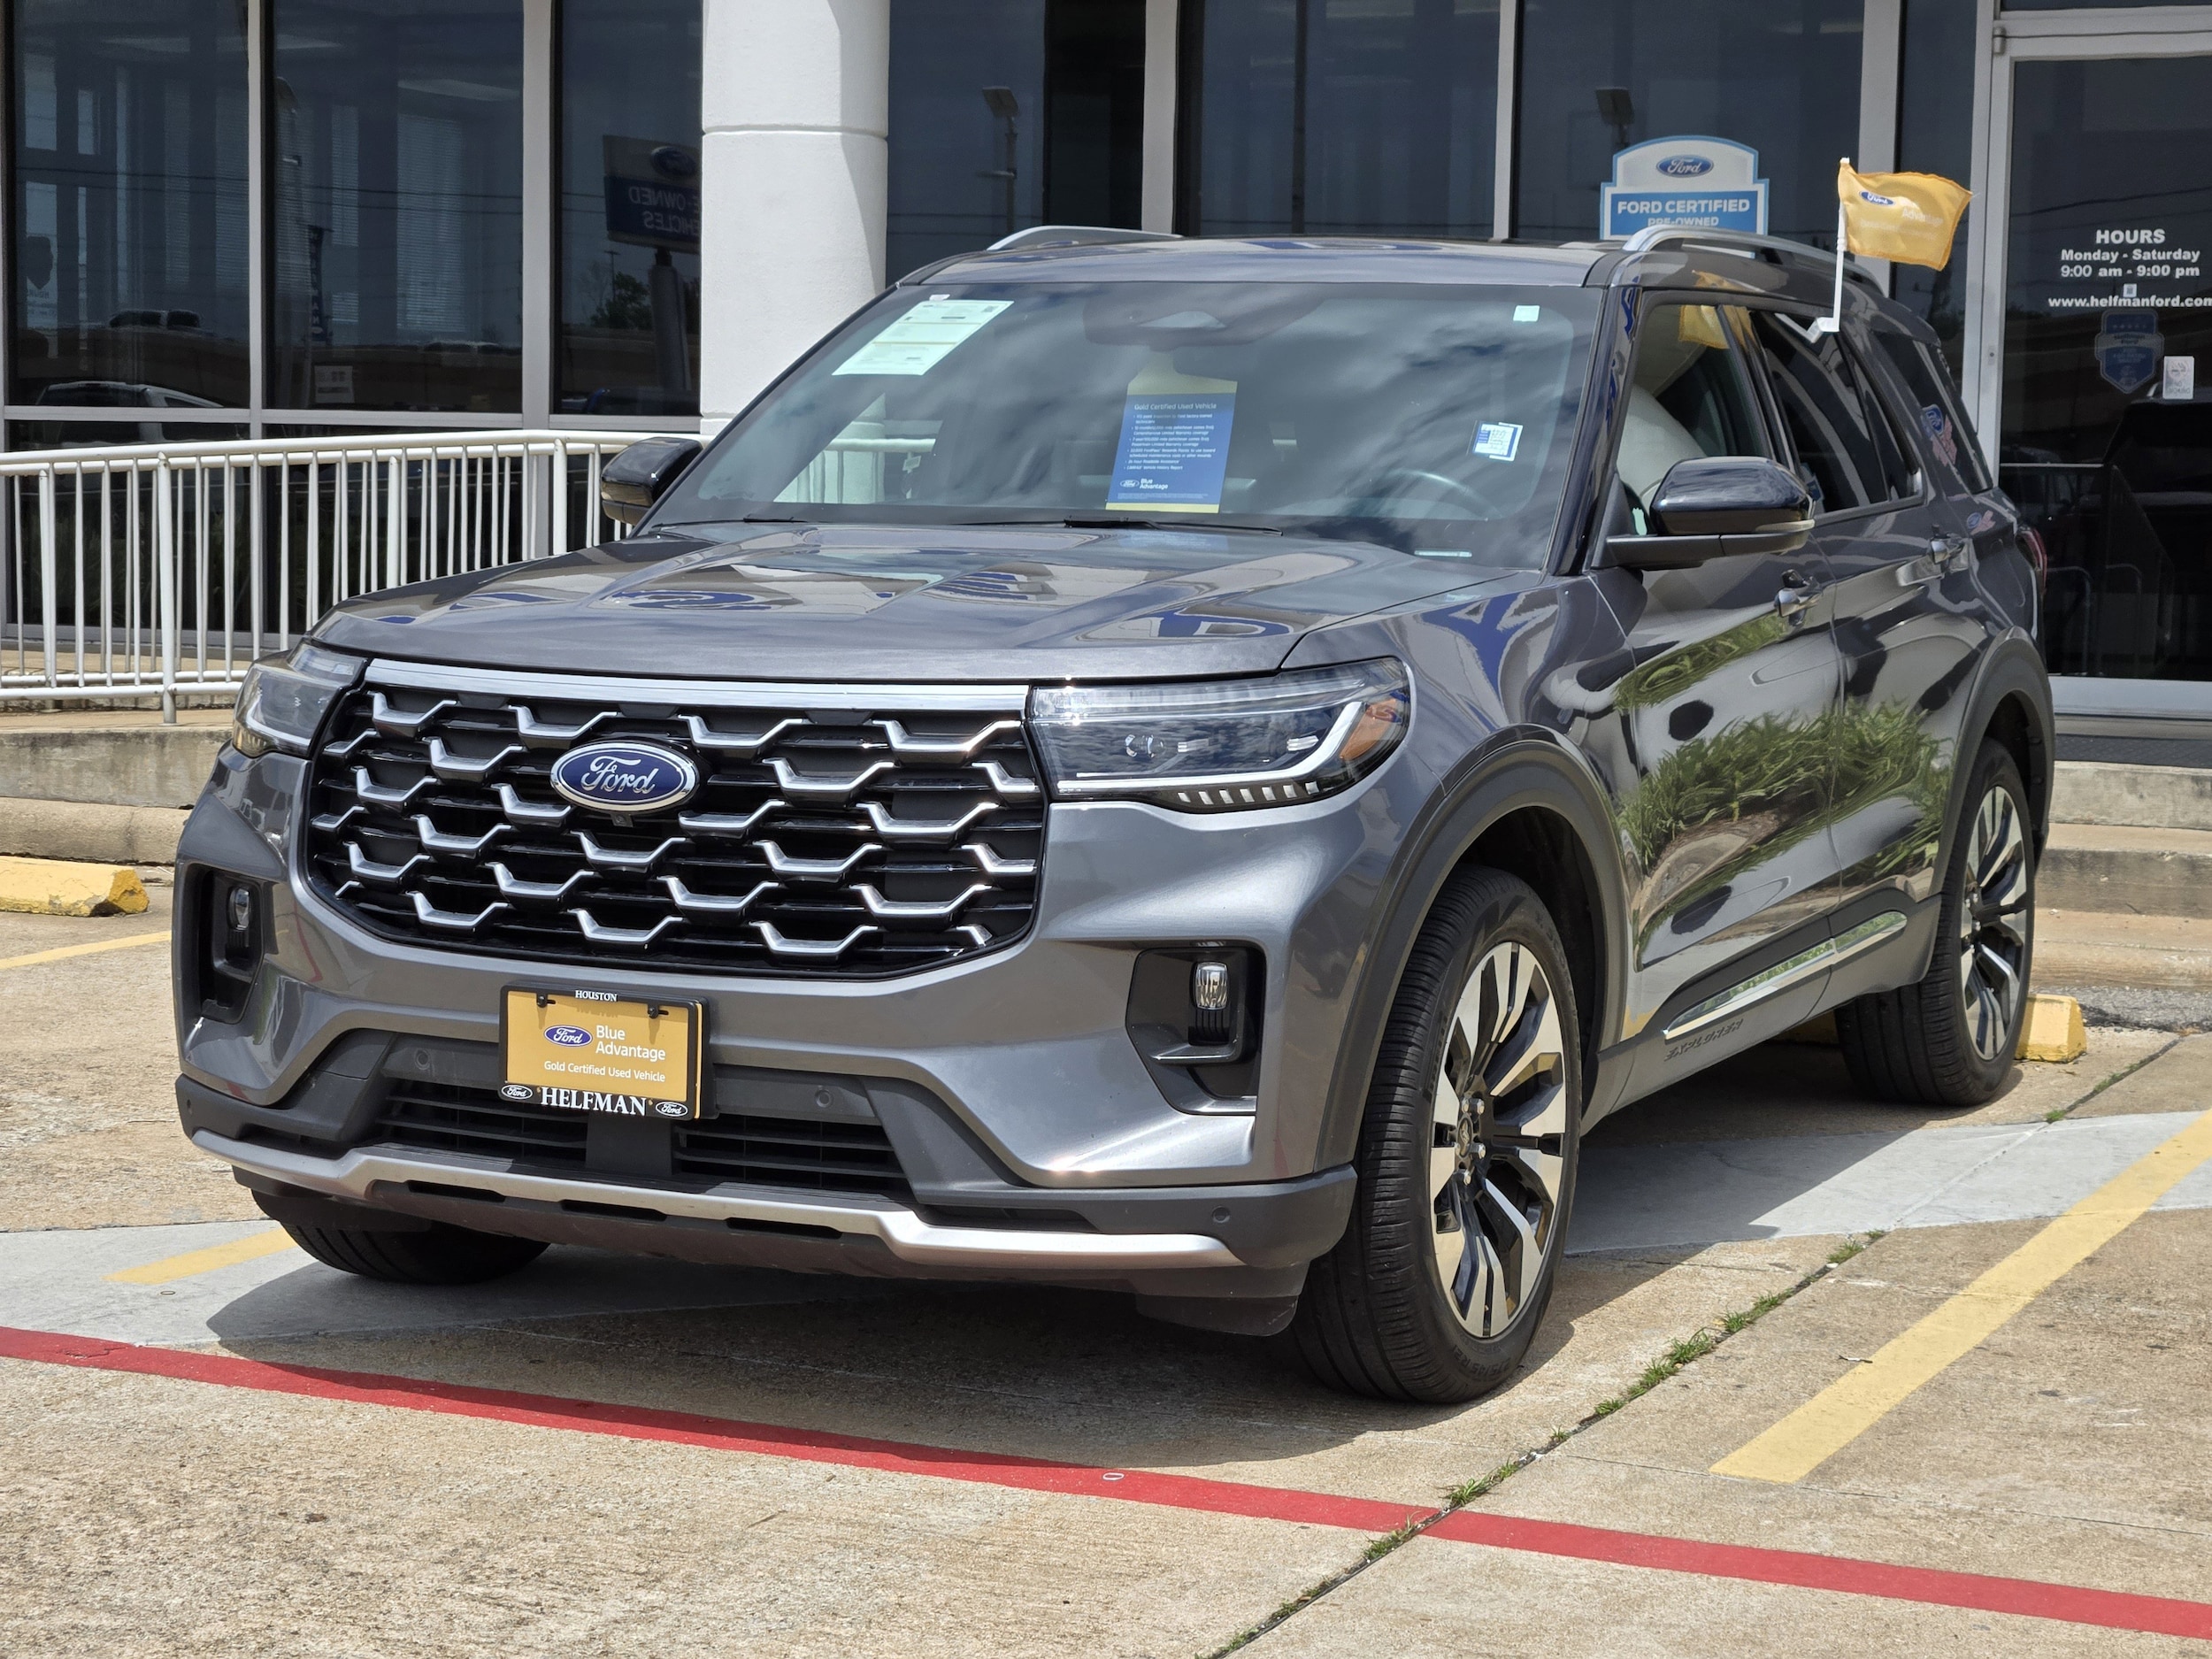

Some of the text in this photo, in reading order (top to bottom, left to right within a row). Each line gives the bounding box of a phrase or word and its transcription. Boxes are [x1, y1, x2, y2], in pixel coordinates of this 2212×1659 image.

[1667, 157, 1702, 174] Ford
[1617, 198, 1750, 215] FORD CERTIFIED
[1647, 217, 1719, 227] PRE-OWNED
[2095, 229, 2166, 244] HOURS
[2061, 249, 2119, 263] Monday
[2131, 249, 2200, 263] Saturday
[2061, 265, 2093, 277] 9:00
[2098, 266, 2123, 277] am
[2136, 265, 2170, 277] 9:00
[2175, 266, 2200, 279] pm
[2048, 295, 2212, 307] www.helfmanford.com
[580, 756, 660, 795] Ford
[575, 990, 618, 1002] HOUSTON
[553, 1025, 626, 1044] Ford Blue
[1663, 1018, 1744, 1062] EXPLORER
[595, 1041, 666, 1062] Advantage
[544, 1061, 665, 1082] Gold Certified Used Vehicle
[540, 1087, 647, 1117] HELFMAN
